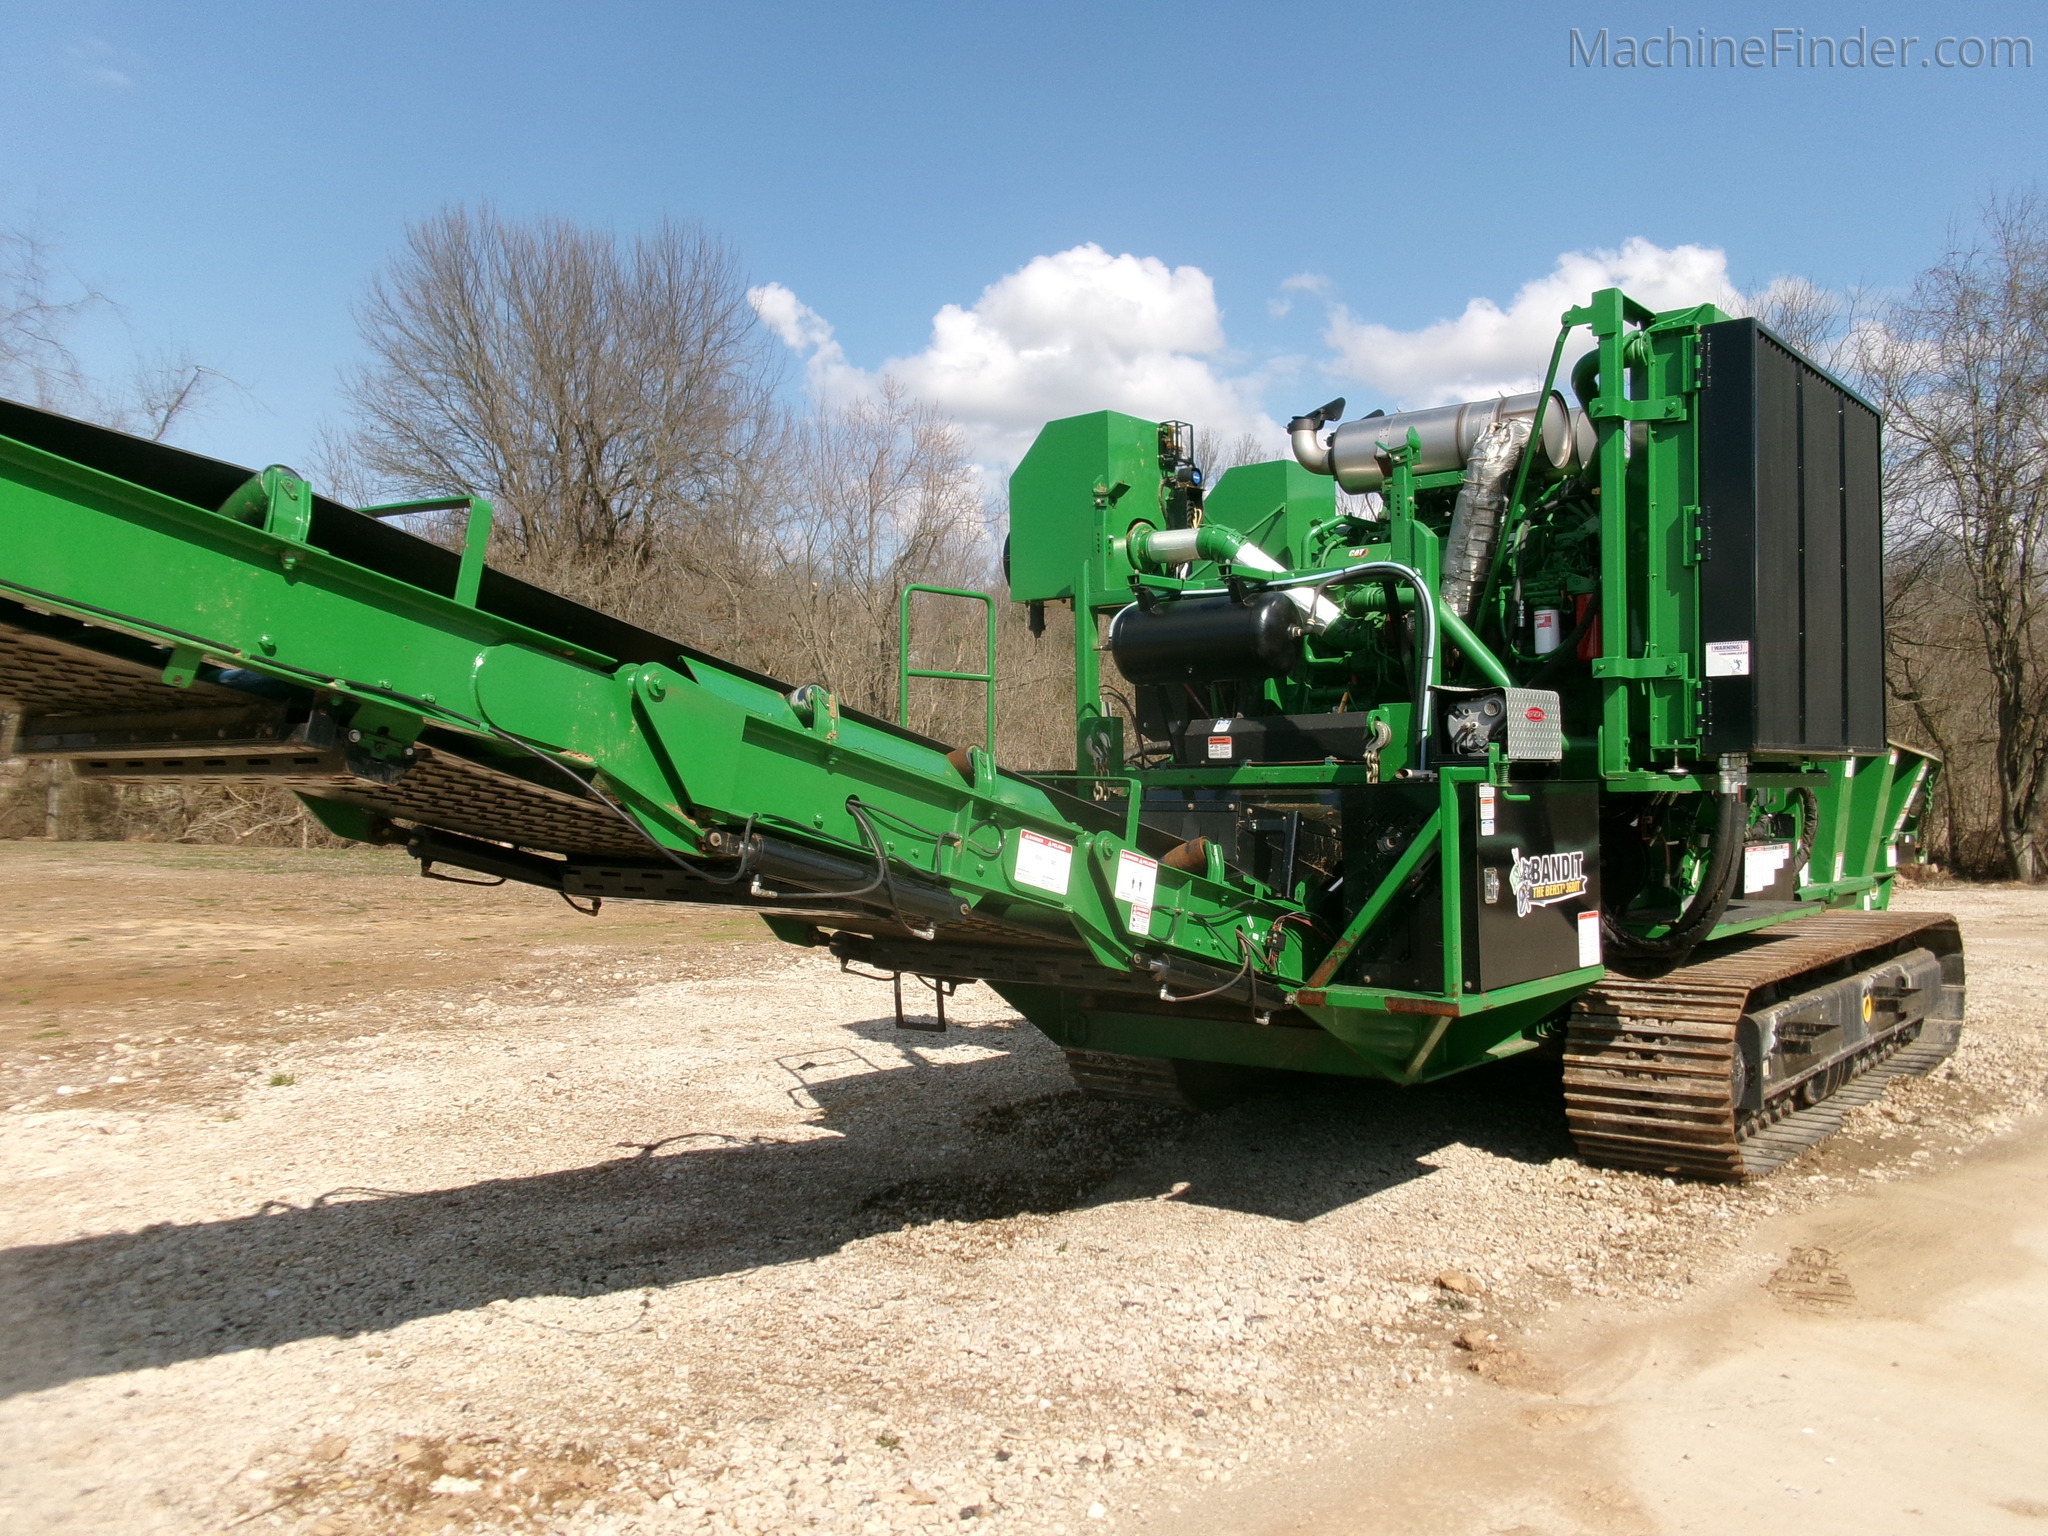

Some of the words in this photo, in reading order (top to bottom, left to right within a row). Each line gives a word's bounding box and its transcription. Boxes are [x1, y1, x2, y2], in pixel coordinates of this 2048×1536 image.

[1348, 548, 1365, 557] CAT
[1530, 852, 1583, 885] BANDIT
[1532, 886, 1545, 898] THE
